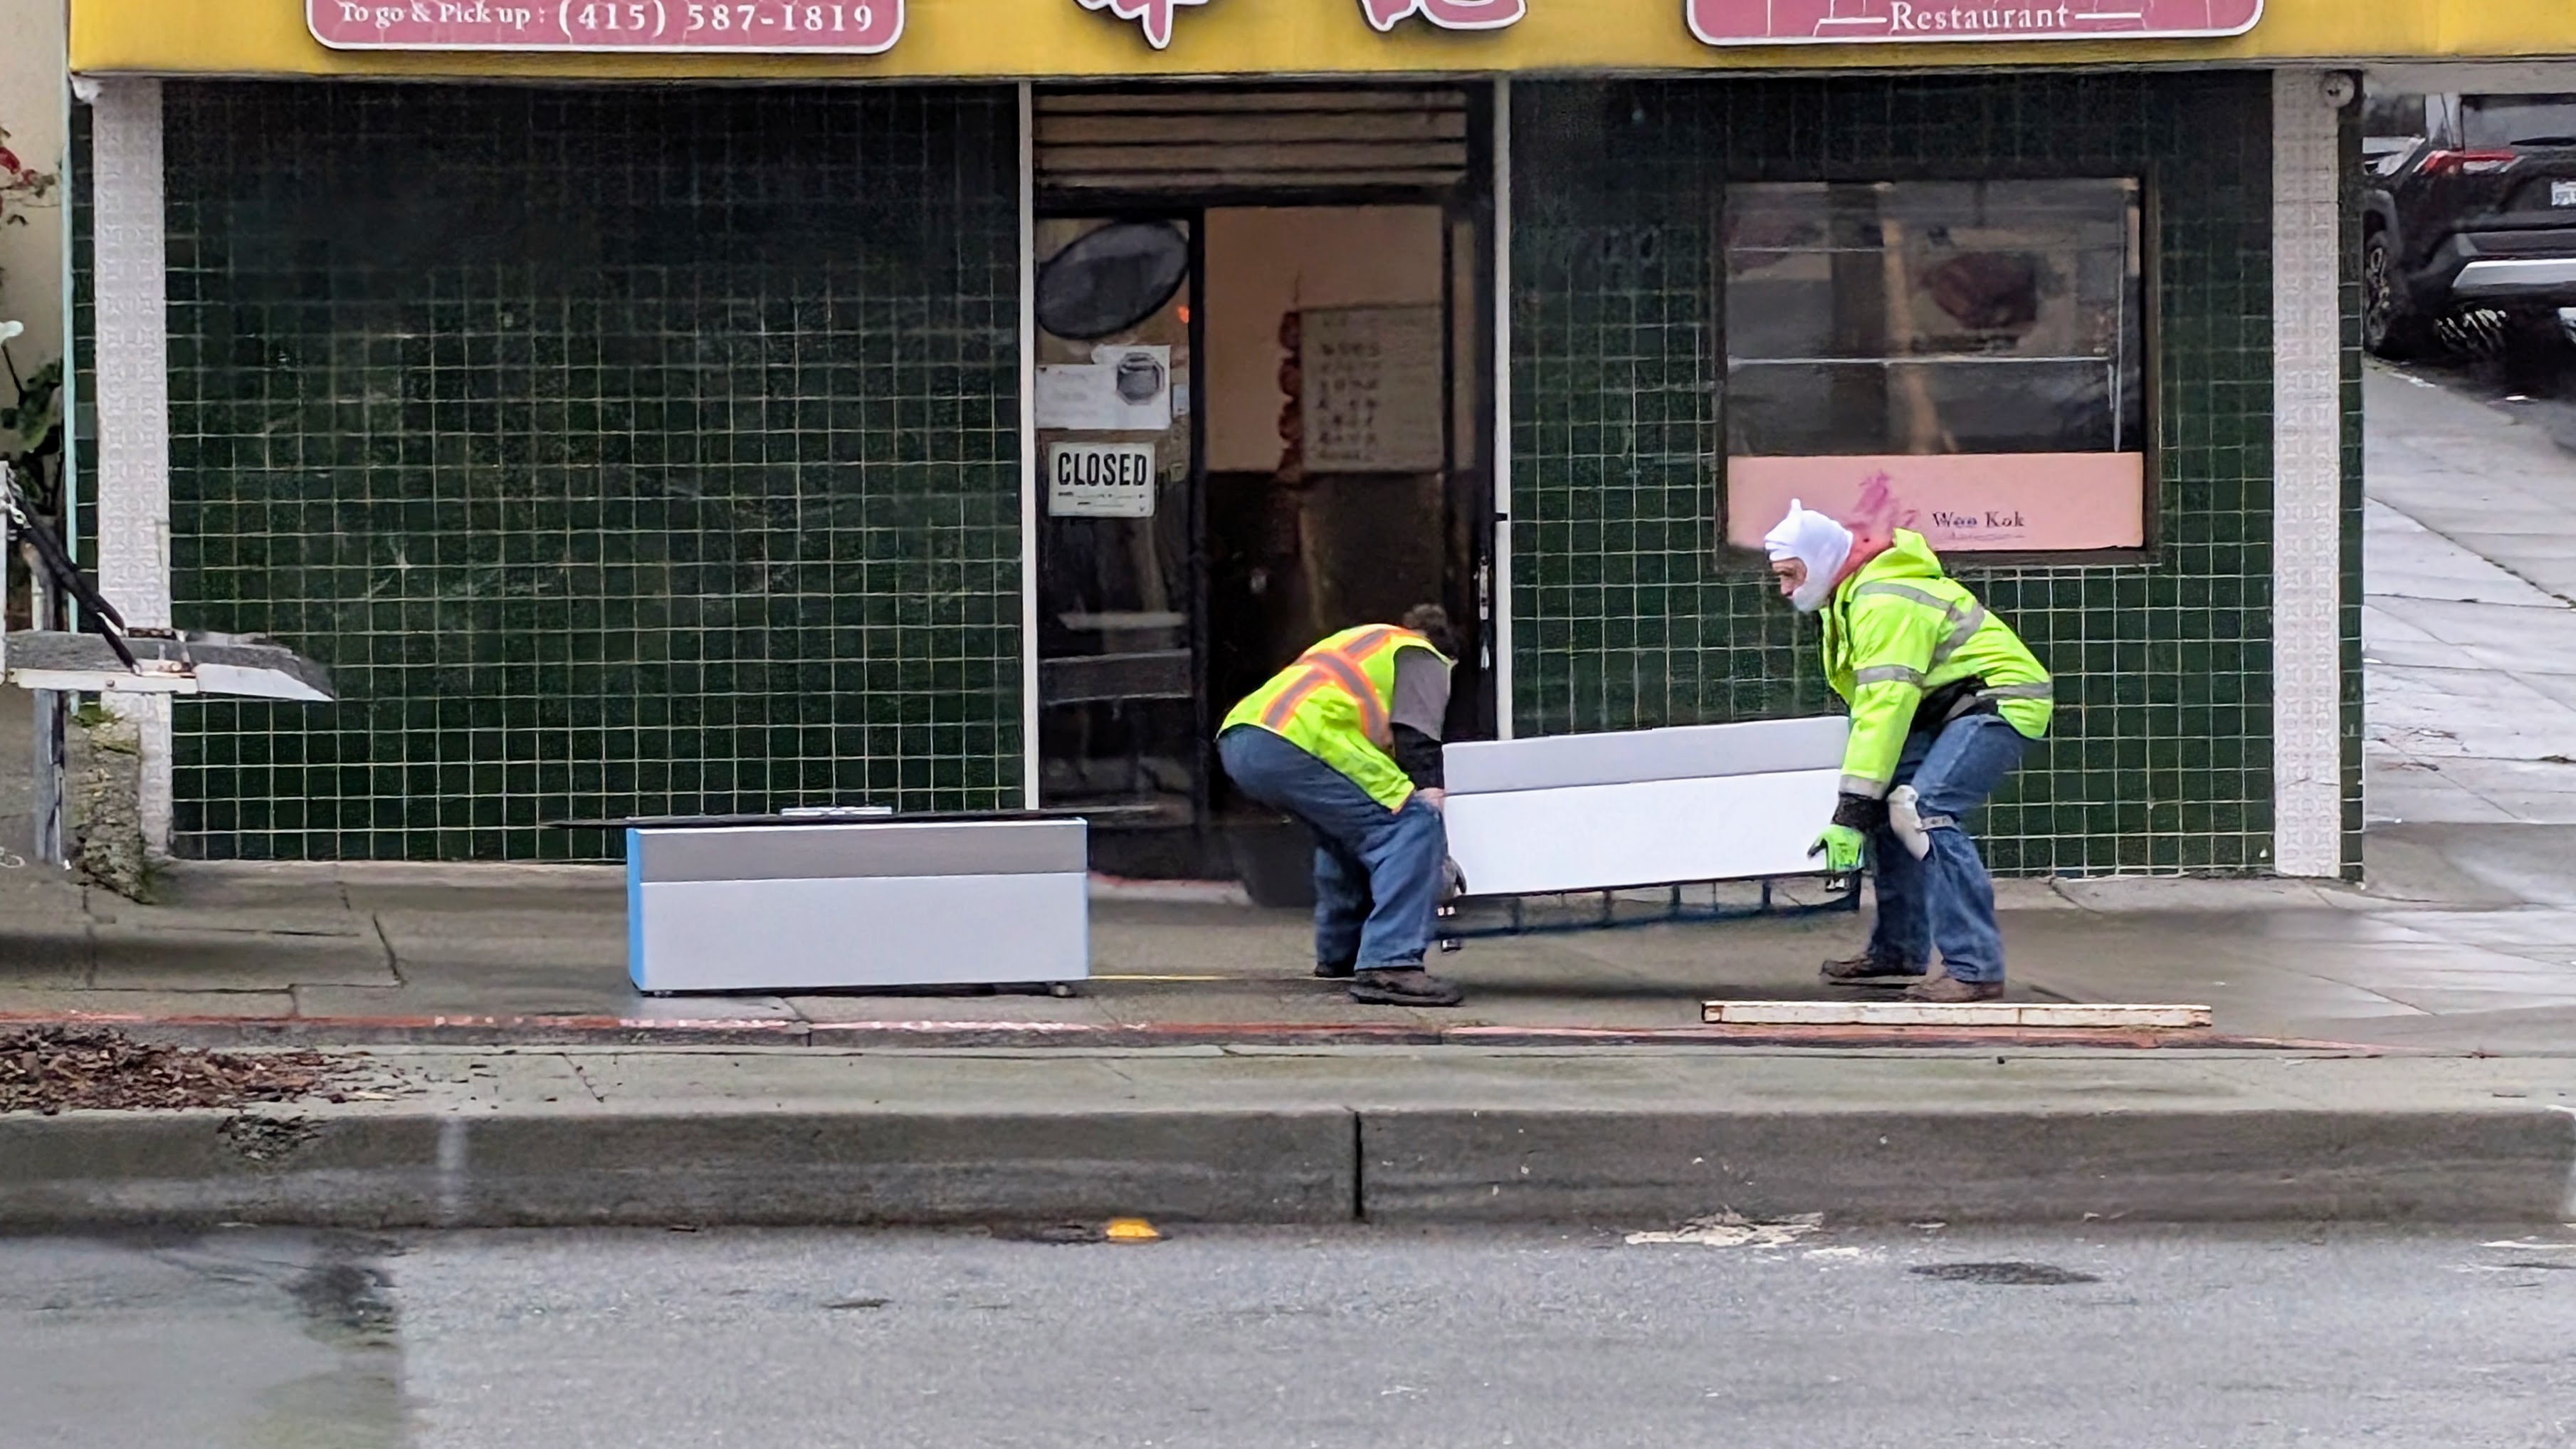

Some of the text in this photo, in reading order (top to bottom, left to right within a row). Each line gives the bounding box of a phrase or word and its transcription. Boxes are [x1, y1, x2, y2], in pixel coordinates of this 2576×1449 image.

[340, 3, 369, 22] To
[375, 7, 405, 29] go
[411, 1, 431, 23] &
[438, 1, 492, 23] Pick
[496, 7, 530, 30] up
[559, 0, 666, 37] (415)
[686, 5, 873, 31] 587-1819
[1891, 1, 2069, 31] Restaurant
[1058, 452, 1147, 486] CLOSED
